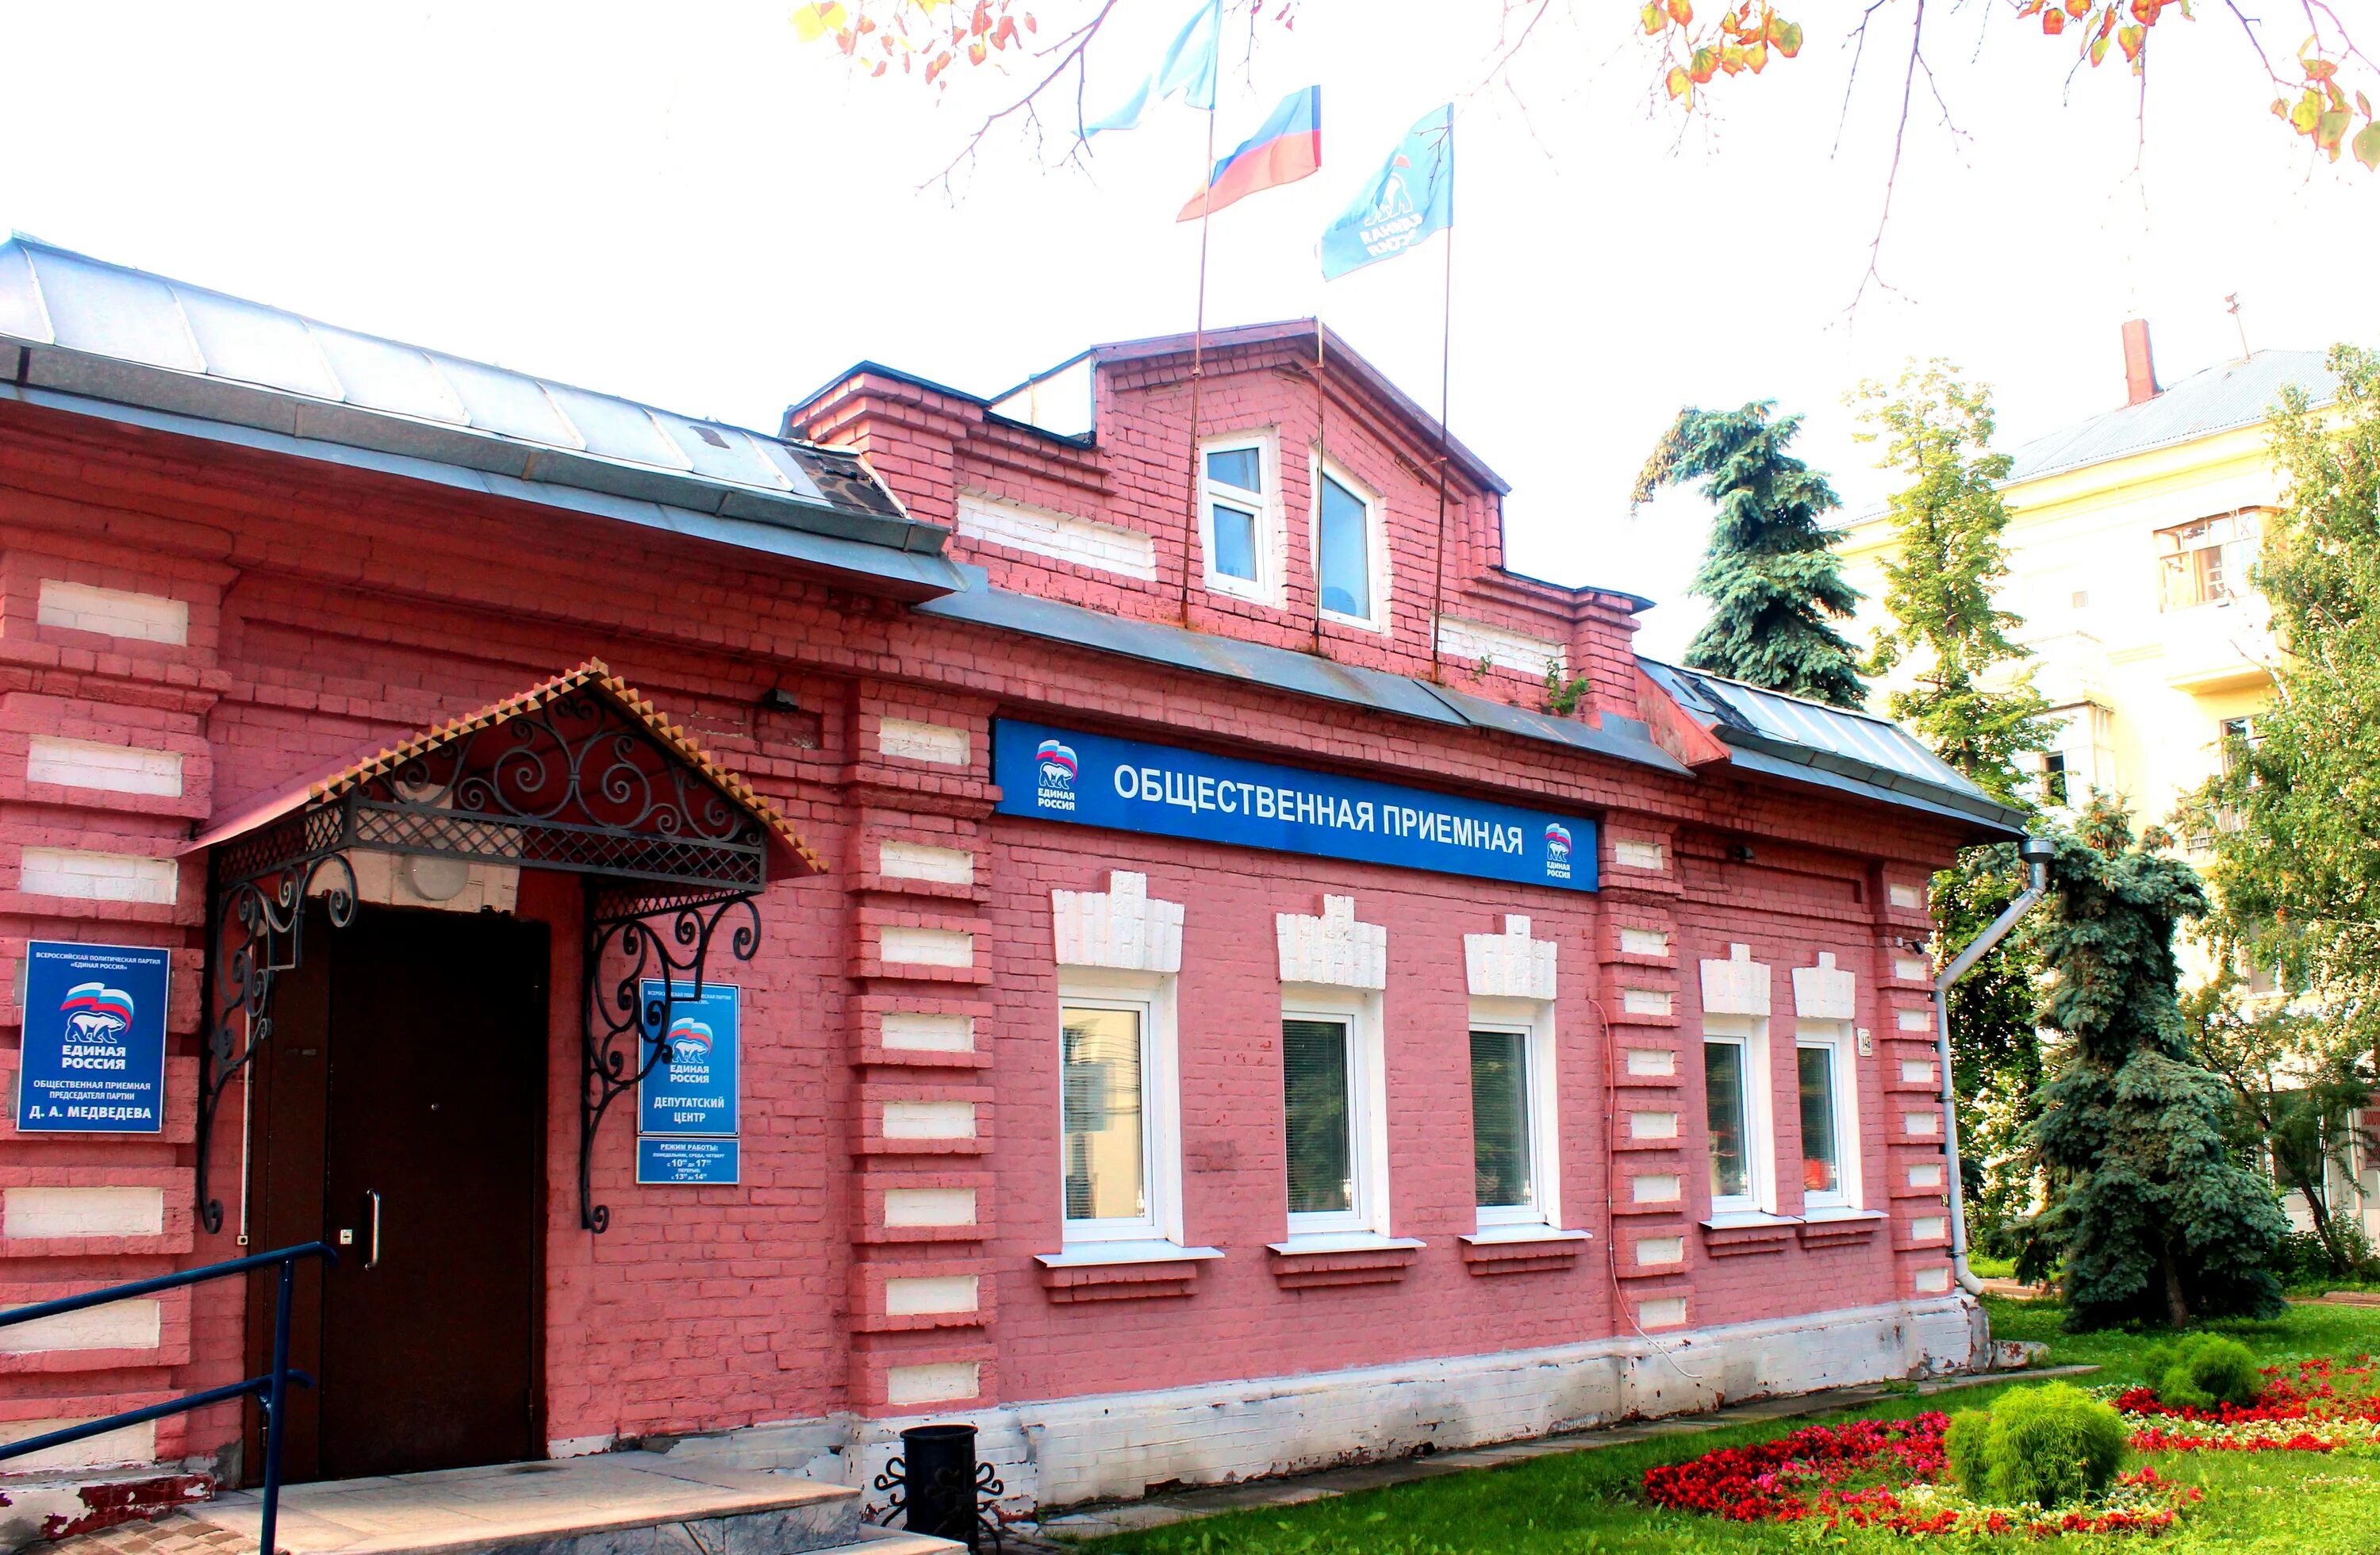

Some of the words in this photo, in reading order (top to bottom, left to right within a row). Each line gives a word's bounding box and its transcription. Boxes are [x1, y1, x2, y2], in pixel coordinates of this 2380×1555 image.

[1038, 787, 1075, 801] ЕДИНАЯ
[1037, 798, 1075, 811] РОССИЯ
[1114, 764, 1373, 832] ОБЩЕСТВЕННАЯ
[1383, 804, 1523, 855] ПРИЕМНАЯ
[1547, 861, 1571, 871] ЕДИНАЯ
[1547, 869, 1571, 879] РОССИЯ
[36, 951, 89, 961] ВСЕРОССИЙСКАЯ
[61, 1045, 126, 1057] ЕДИНАЯ
[61, 1057, 126, 1069] РОССИЯ
[670, 1065, 710, 1074] ЕДИНАЯ
[670, 1073, 710, 1083] РОССИЯ
[33, 1080, 103, 1089] ОБЩЕСТВЕННАЯ
[105, 1081, 151, 1090] ПРИЕМНАЯ
[49, 1091, 105, 1100] ПРЕДСЕДАТЕЛЯ
[653, 1096, 724, 1109] ДЕПУТАТСКИЙ
[29, 1105, 44, 1119] Д.
[48, 1106, 63, 1117] А.
[67, 1106, 152, 1120] МЕДВЕДЕВА
[673, 1112, 706, 1124] ЦЕНТР
